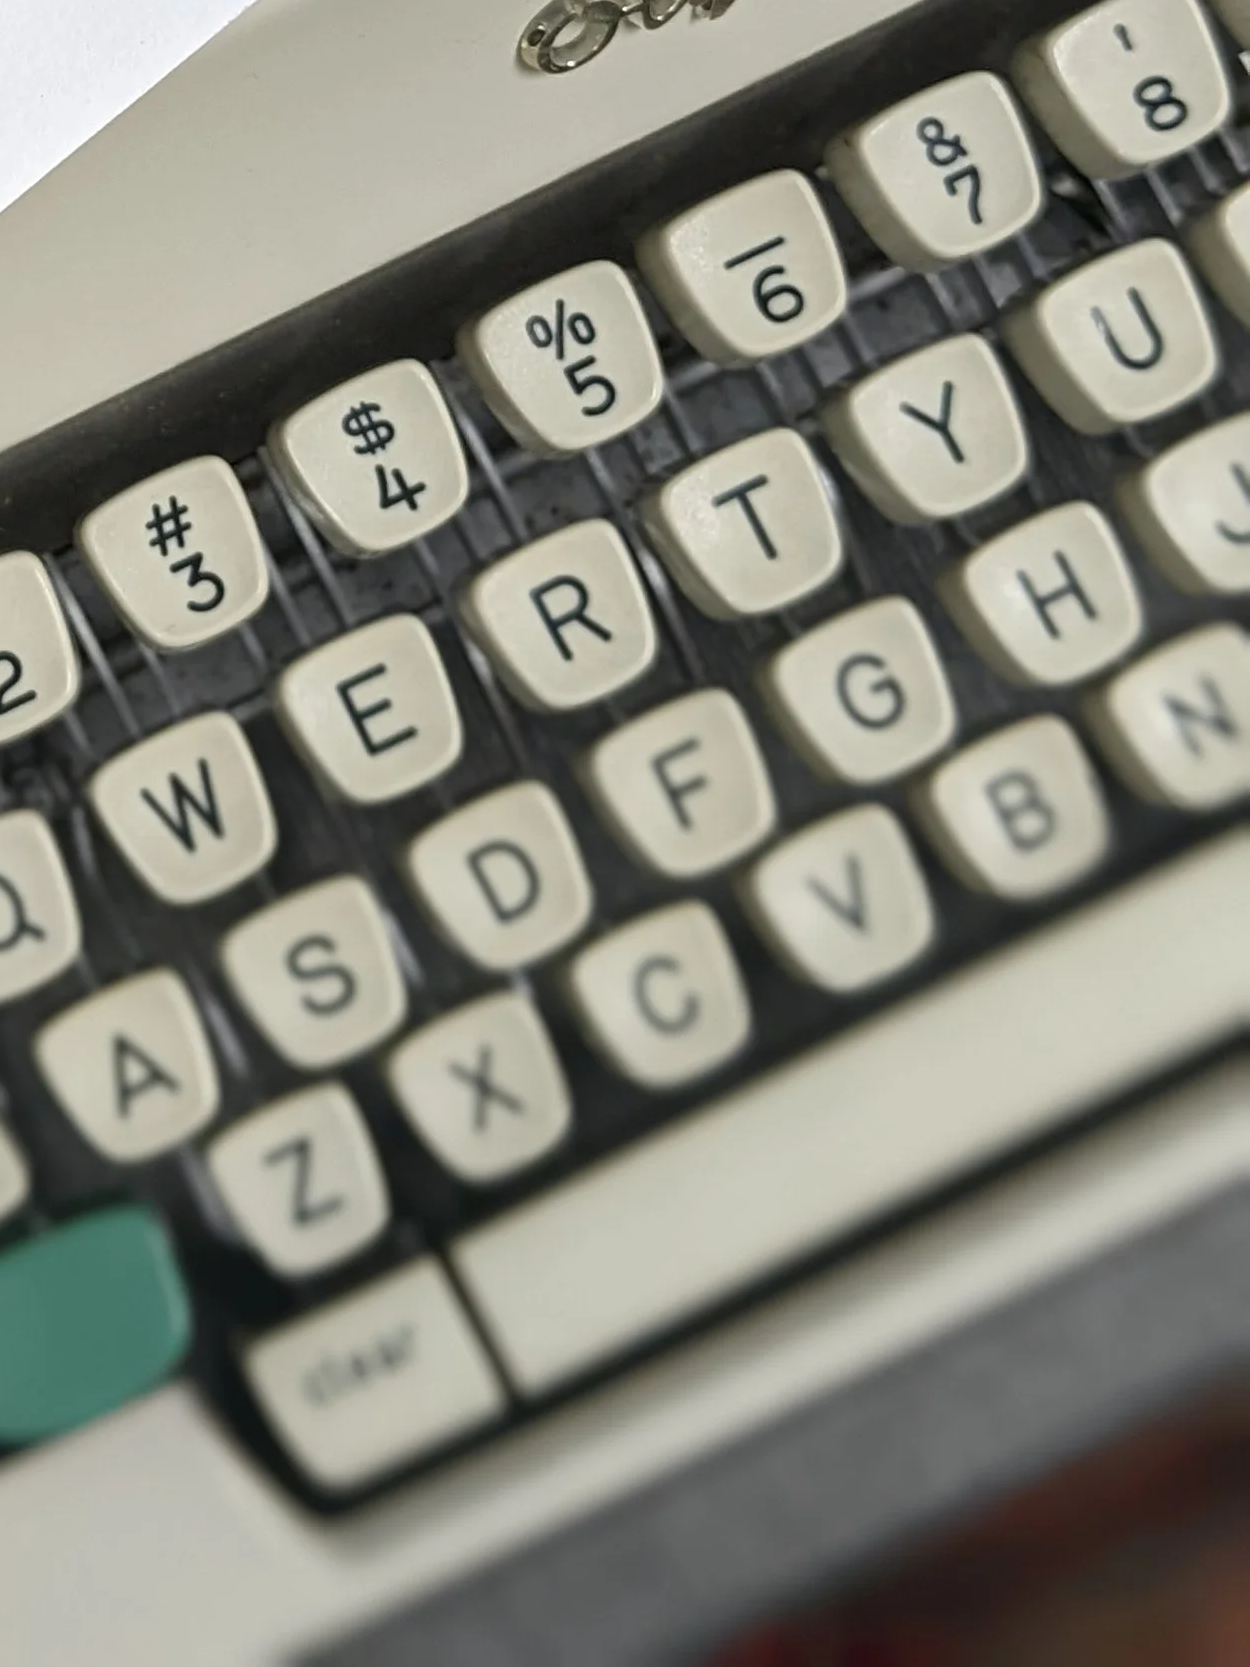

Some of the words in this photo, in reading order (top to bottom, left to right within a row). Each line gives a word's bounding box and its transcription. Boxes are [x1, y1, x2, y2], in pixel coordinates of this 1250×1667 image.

[1132, 75, 1188, 132] 8
[944, 166, 983, 224] 7
[525, 299, 596, 360] %
[752, 265, 804, 323] 6
[1091, 286, 1164, 371] U
[563, 356, 617, 417] 5
[900, 381, 965, 464] Y
[341, 401, 397, 456] $
[145, 495, 192, 556] #
[373, 465, 427, 512] 4
[712, 474, 779, 561] T
[170, 552, 225, 613] 3
[529, 574, 613, 661] R
[1016, 551, 1099, 641] H
[336, 664, 419, 756] E
[835, 652, 907, 731] G
[1162, 674, 1237, 759] N
[140, 758, 226, 853] W
[649, 738, 709, 832] F
[985, 771, 1056, 854] B
[467, 839, 541, 924] D
[806, 853, 867, 935] V
[284, 935, 357, 1017] S
[632, 954, 700, 1036] C
[109, 1034, 179, 1120] A
[447, 1044, 525, 1133] X
[262, 1137, 344, 1230] Z
